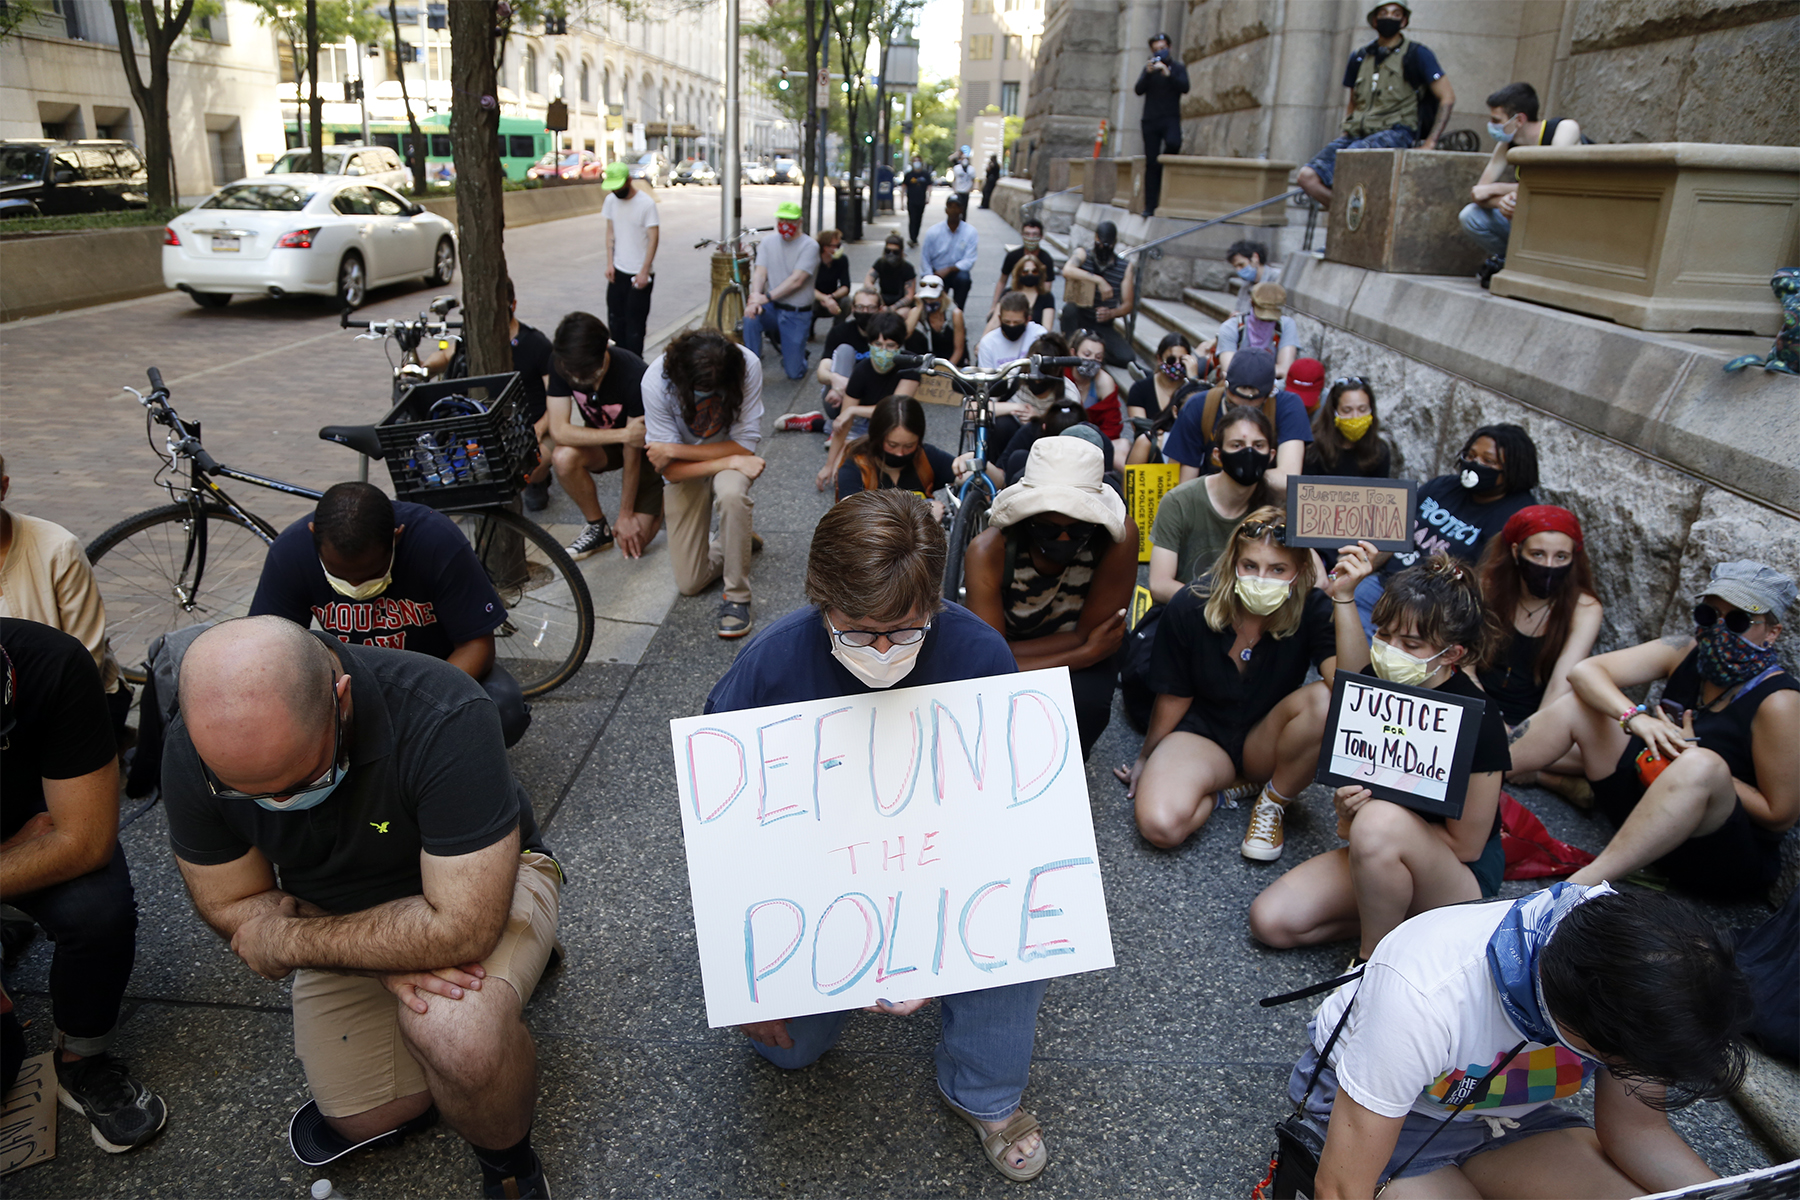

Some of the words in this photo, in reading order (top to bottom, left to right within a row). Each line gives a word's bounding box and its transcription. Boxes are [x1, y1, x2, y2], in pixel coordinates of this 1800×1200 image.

[1300, 485, 1360, 503] JUSTICE
[1366, 488, 1397, 505] FOR
[1301, 503, 1404, 539] BREONNA
[1348, 684, 1449, 733] JUSTICE
[1382, 725, 1406, 736] FOR
[685, 688, 1070, 827] DEFUND
[1340, 728, 1378, 776] Tony
[1381, 736, 1447, 781] McDade
[828, 830, 942, 875] THE
[743, 856, 1094, 1004] POLICE
